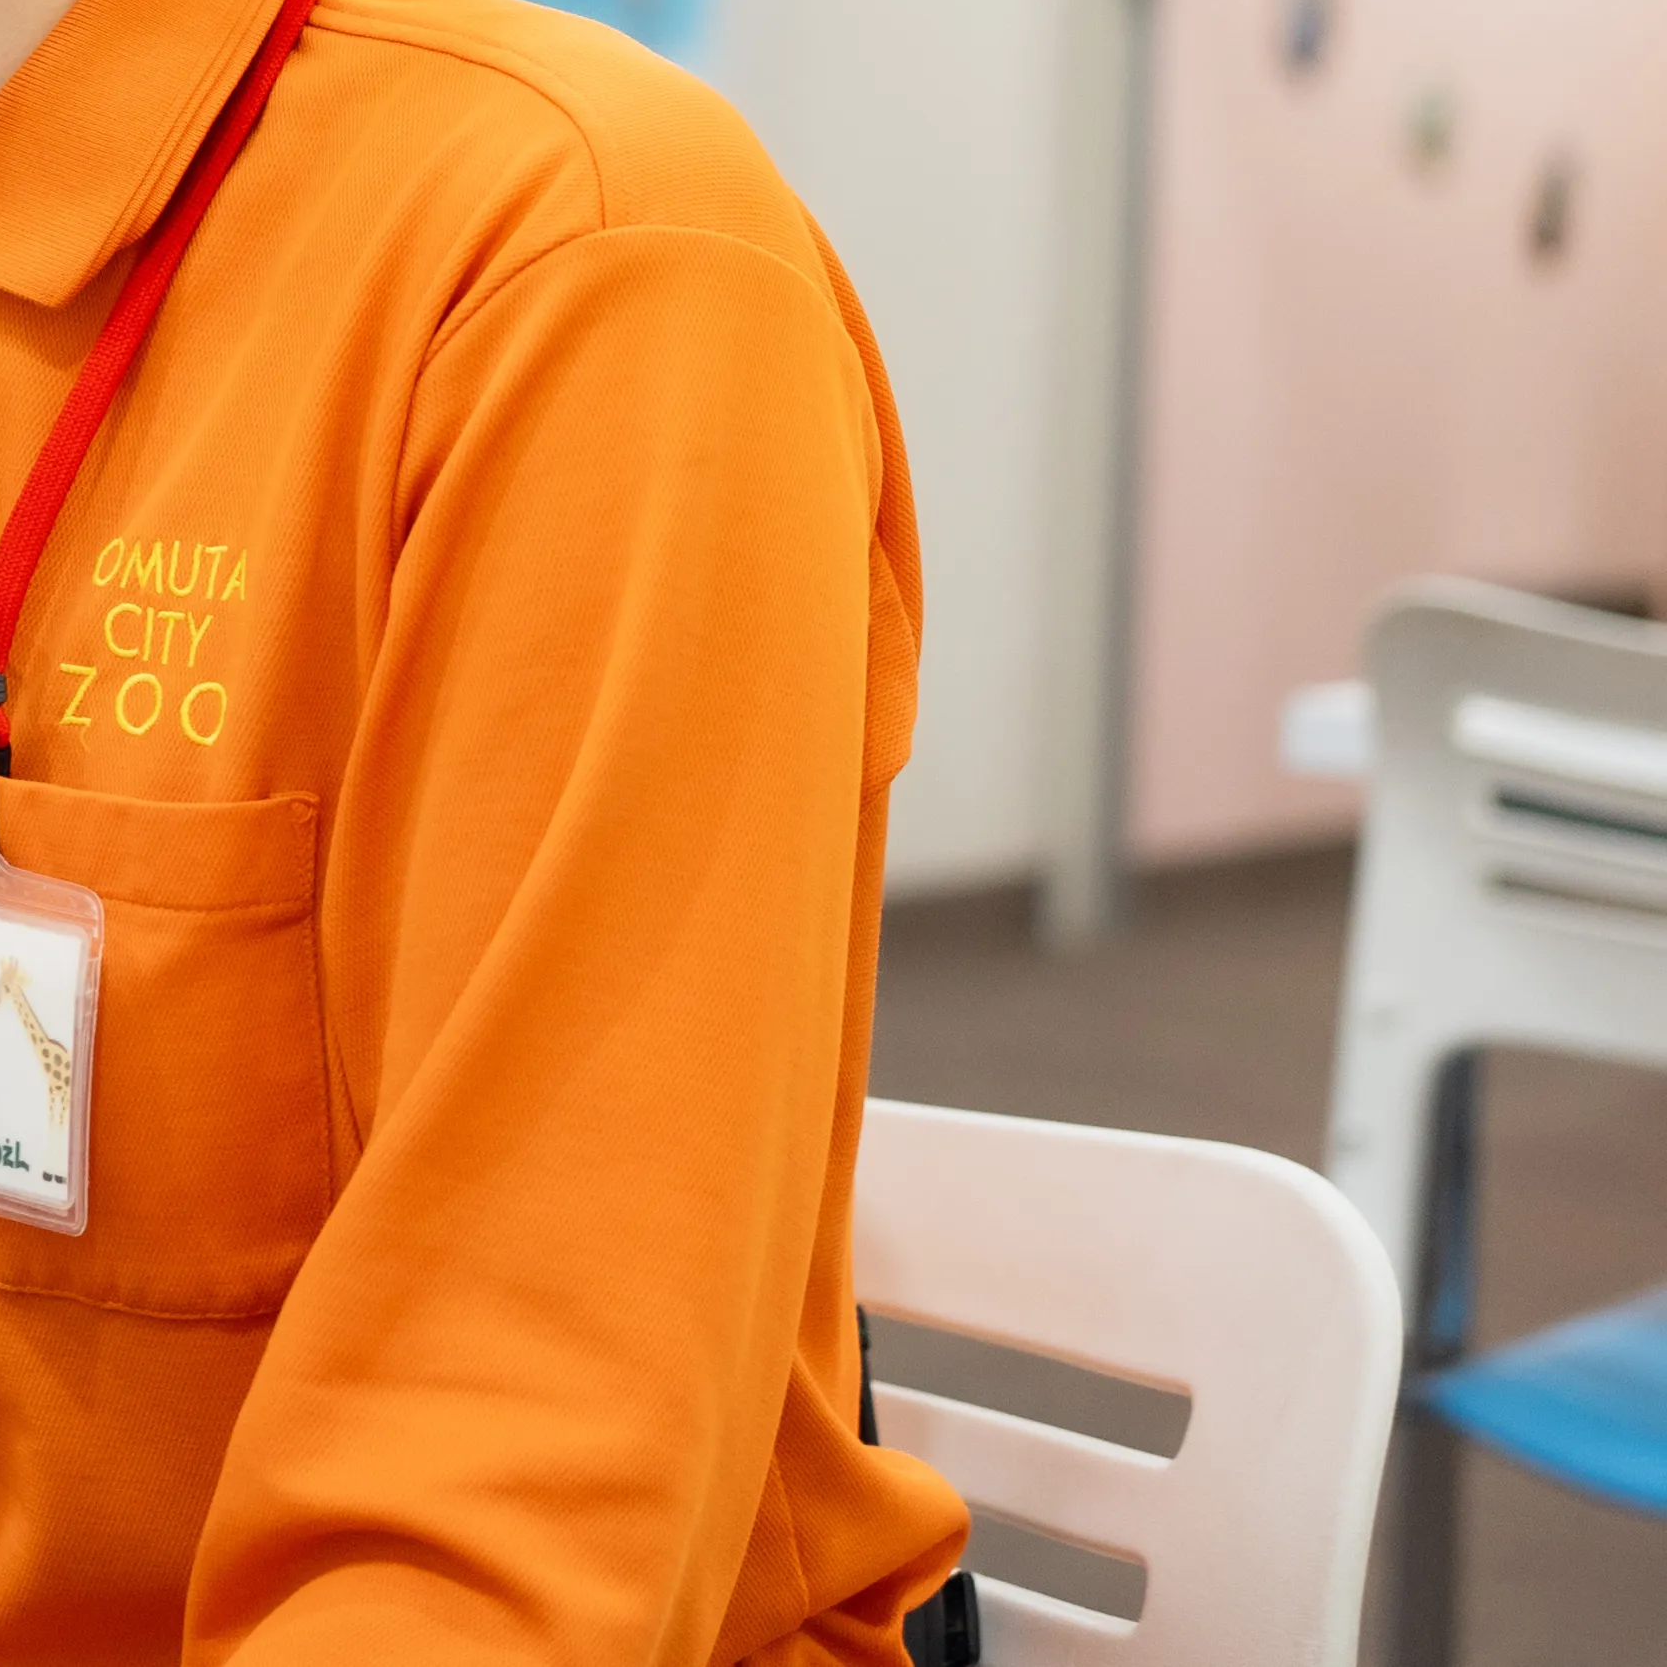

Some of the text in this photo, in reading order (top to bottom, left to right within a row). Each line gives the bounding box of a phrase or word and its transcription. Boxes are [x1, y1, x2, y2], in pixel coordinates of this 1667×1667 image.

[92, 537, 247, 602] OMUTA
[104, 602, 214, 668] CITY
[59, 662, 228, 747] ZOO
